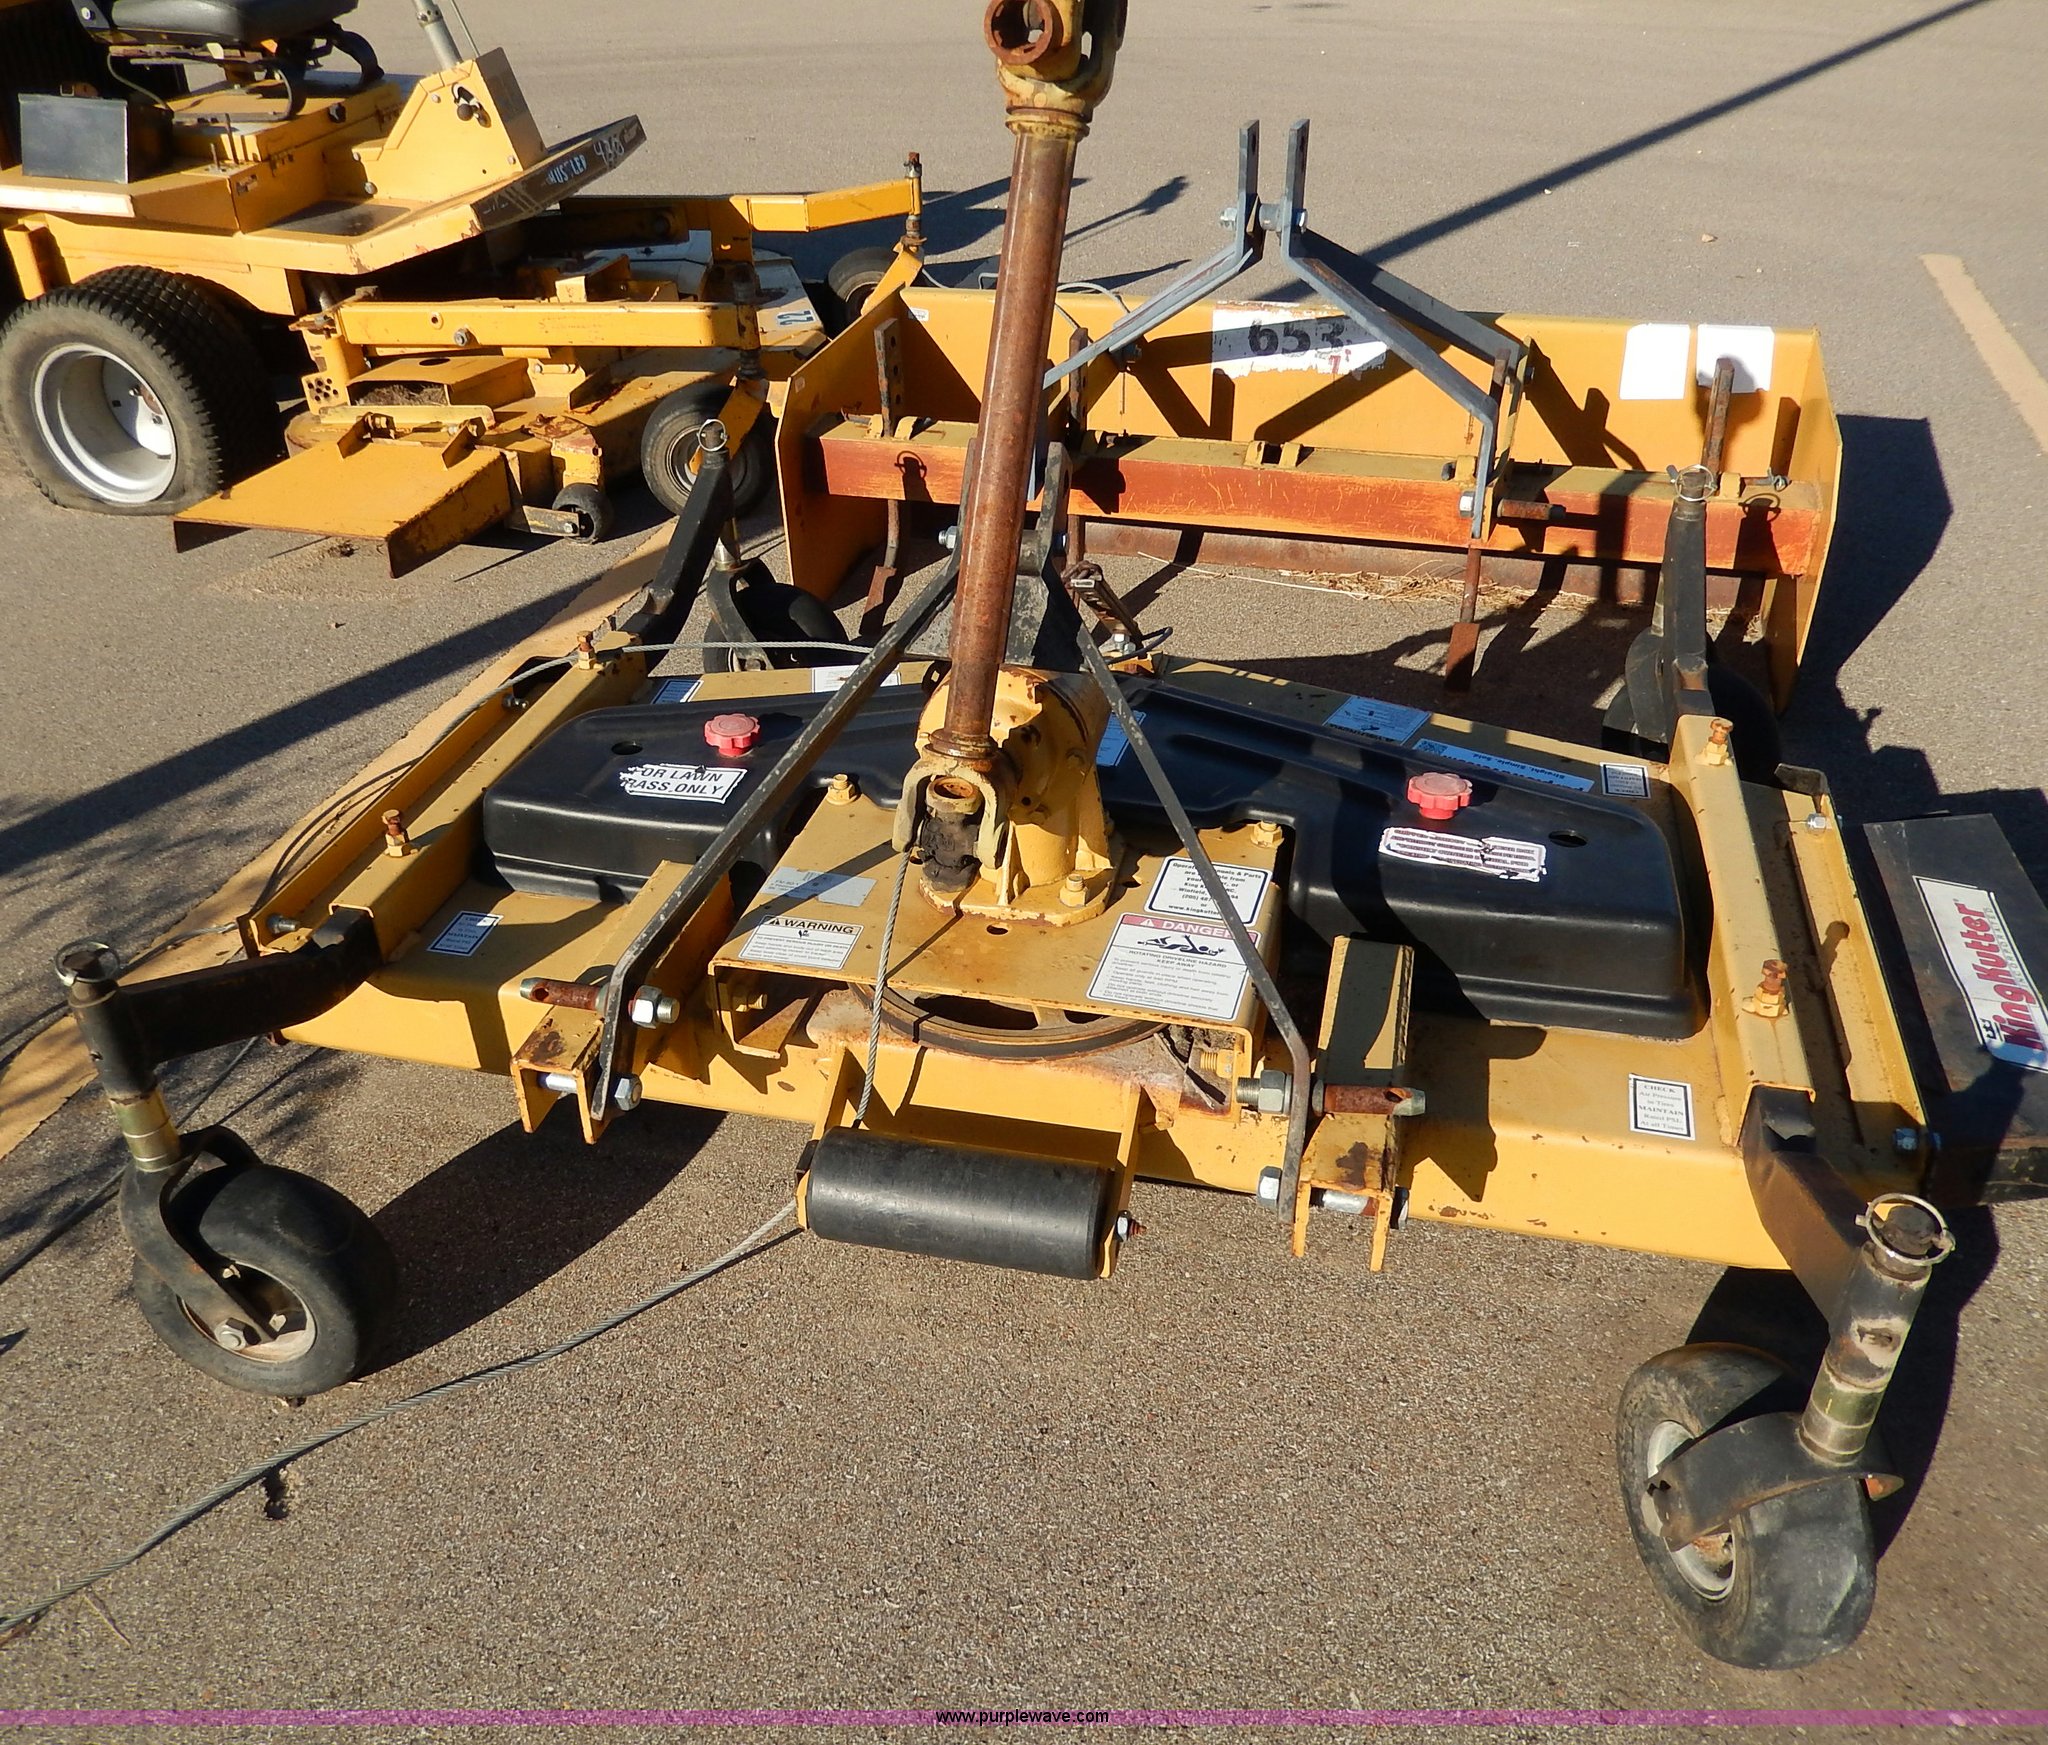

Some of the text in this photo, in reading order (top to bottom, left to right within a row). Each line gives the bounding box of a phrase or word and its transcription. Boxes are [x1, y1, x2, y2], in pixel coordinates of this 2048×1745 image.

[670, 770, 723, 782] LAWN
[674, 783, 724, 795] ONLY
[785, 919, 854, 934] WARNING
[1644, 1085, 1676, 1093] CHECK
[1639, 1105, 1684, 1116] MAINTAIN
